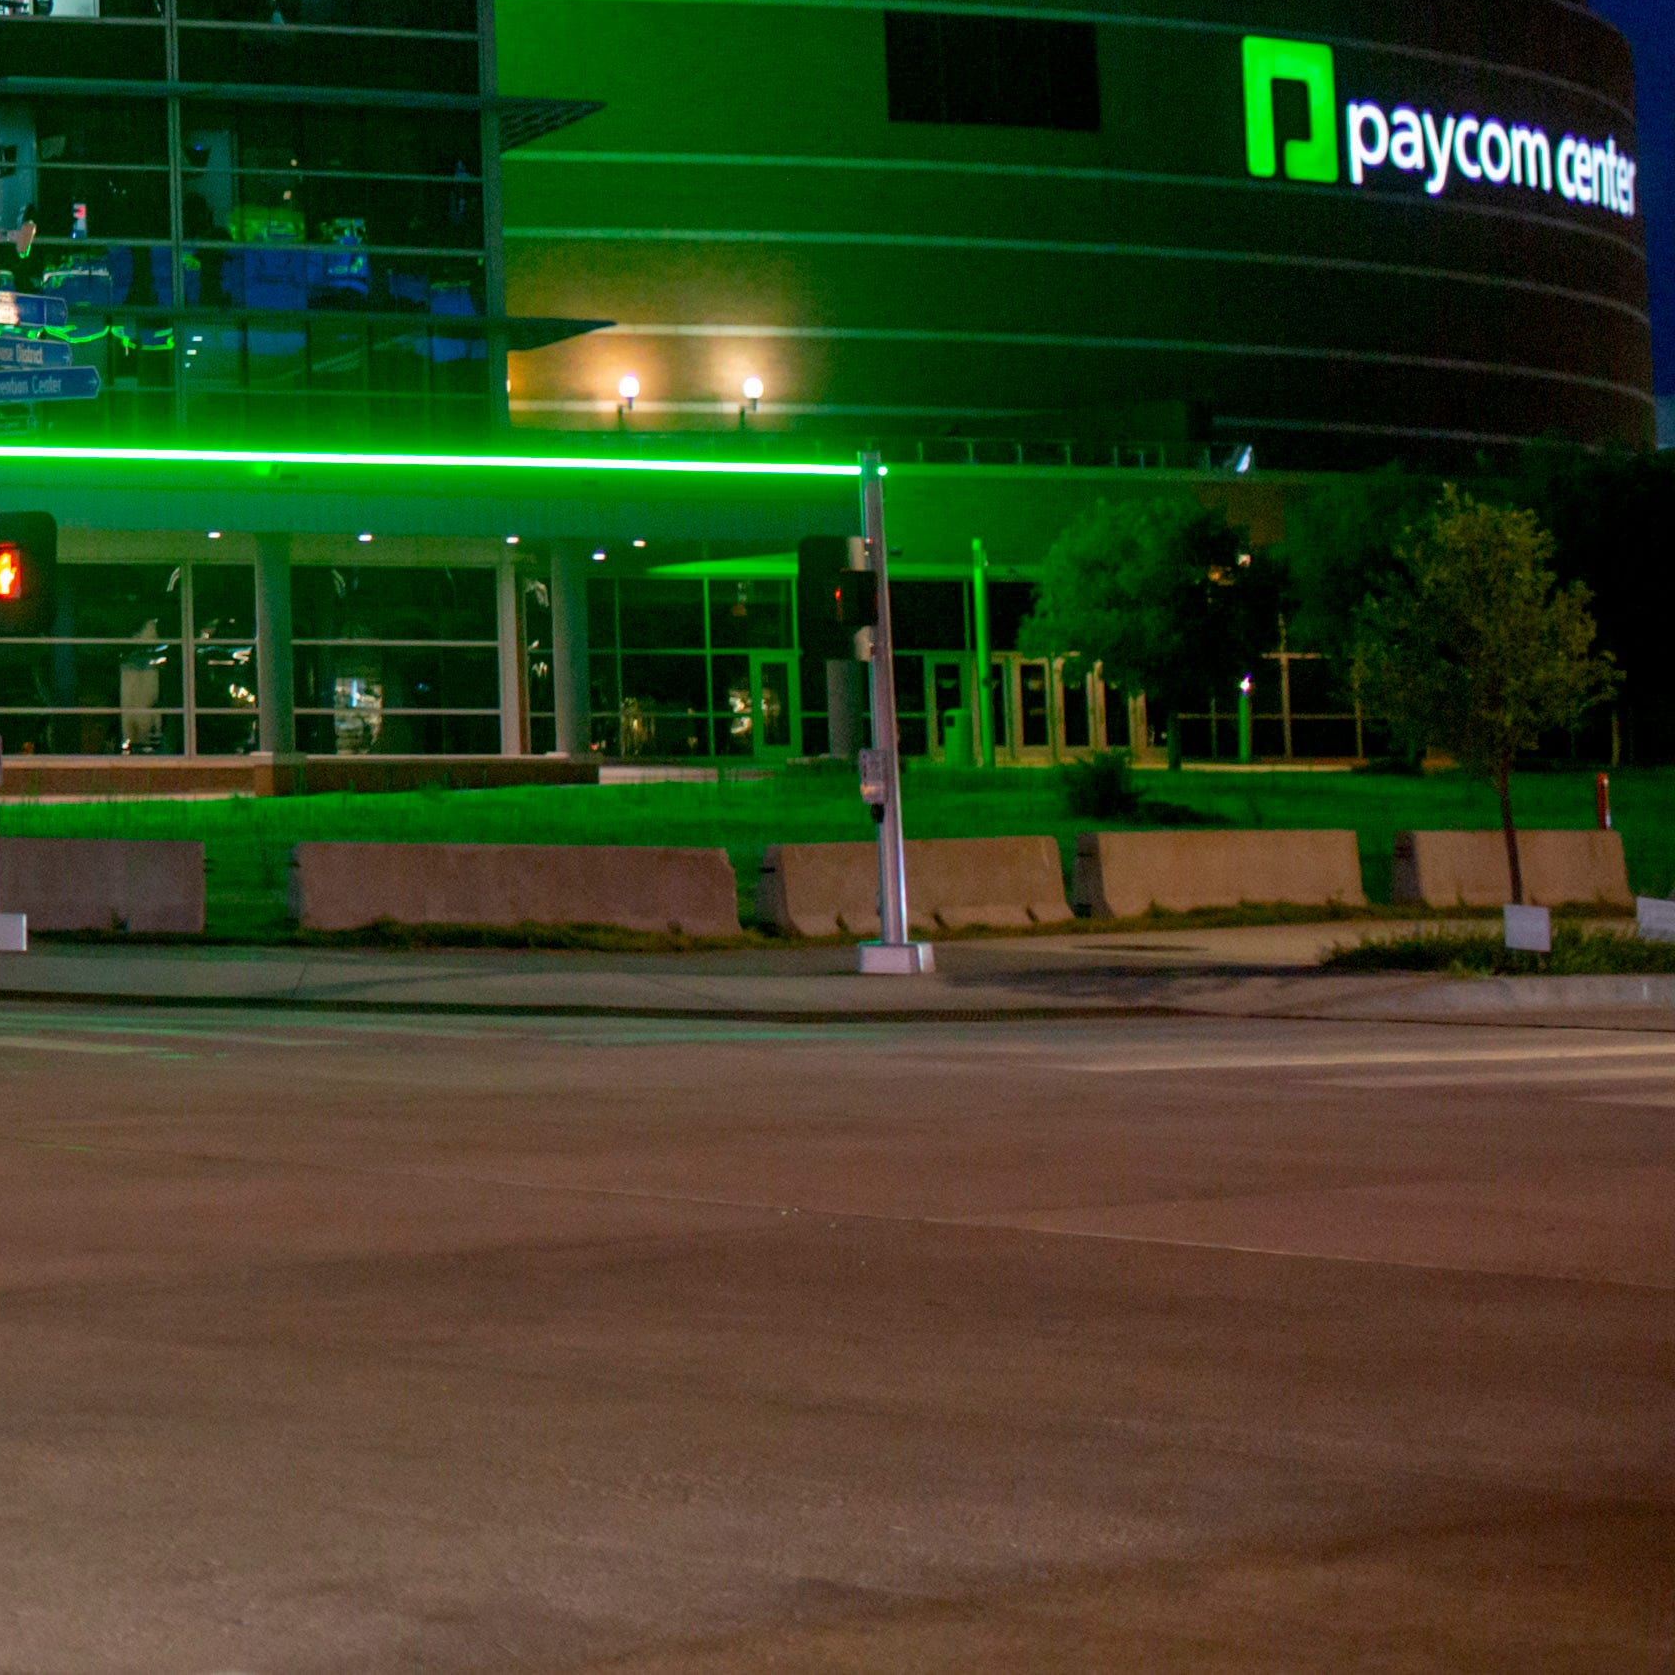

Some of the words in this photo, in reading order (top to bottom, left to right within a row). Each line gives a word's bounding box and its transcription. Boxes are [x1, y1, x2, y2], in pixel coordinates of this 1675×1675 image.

[1346, 100, 1553, 196] paycom
[1556, 132, 1636, 217] center
[32, 375, 62, 395] Center
